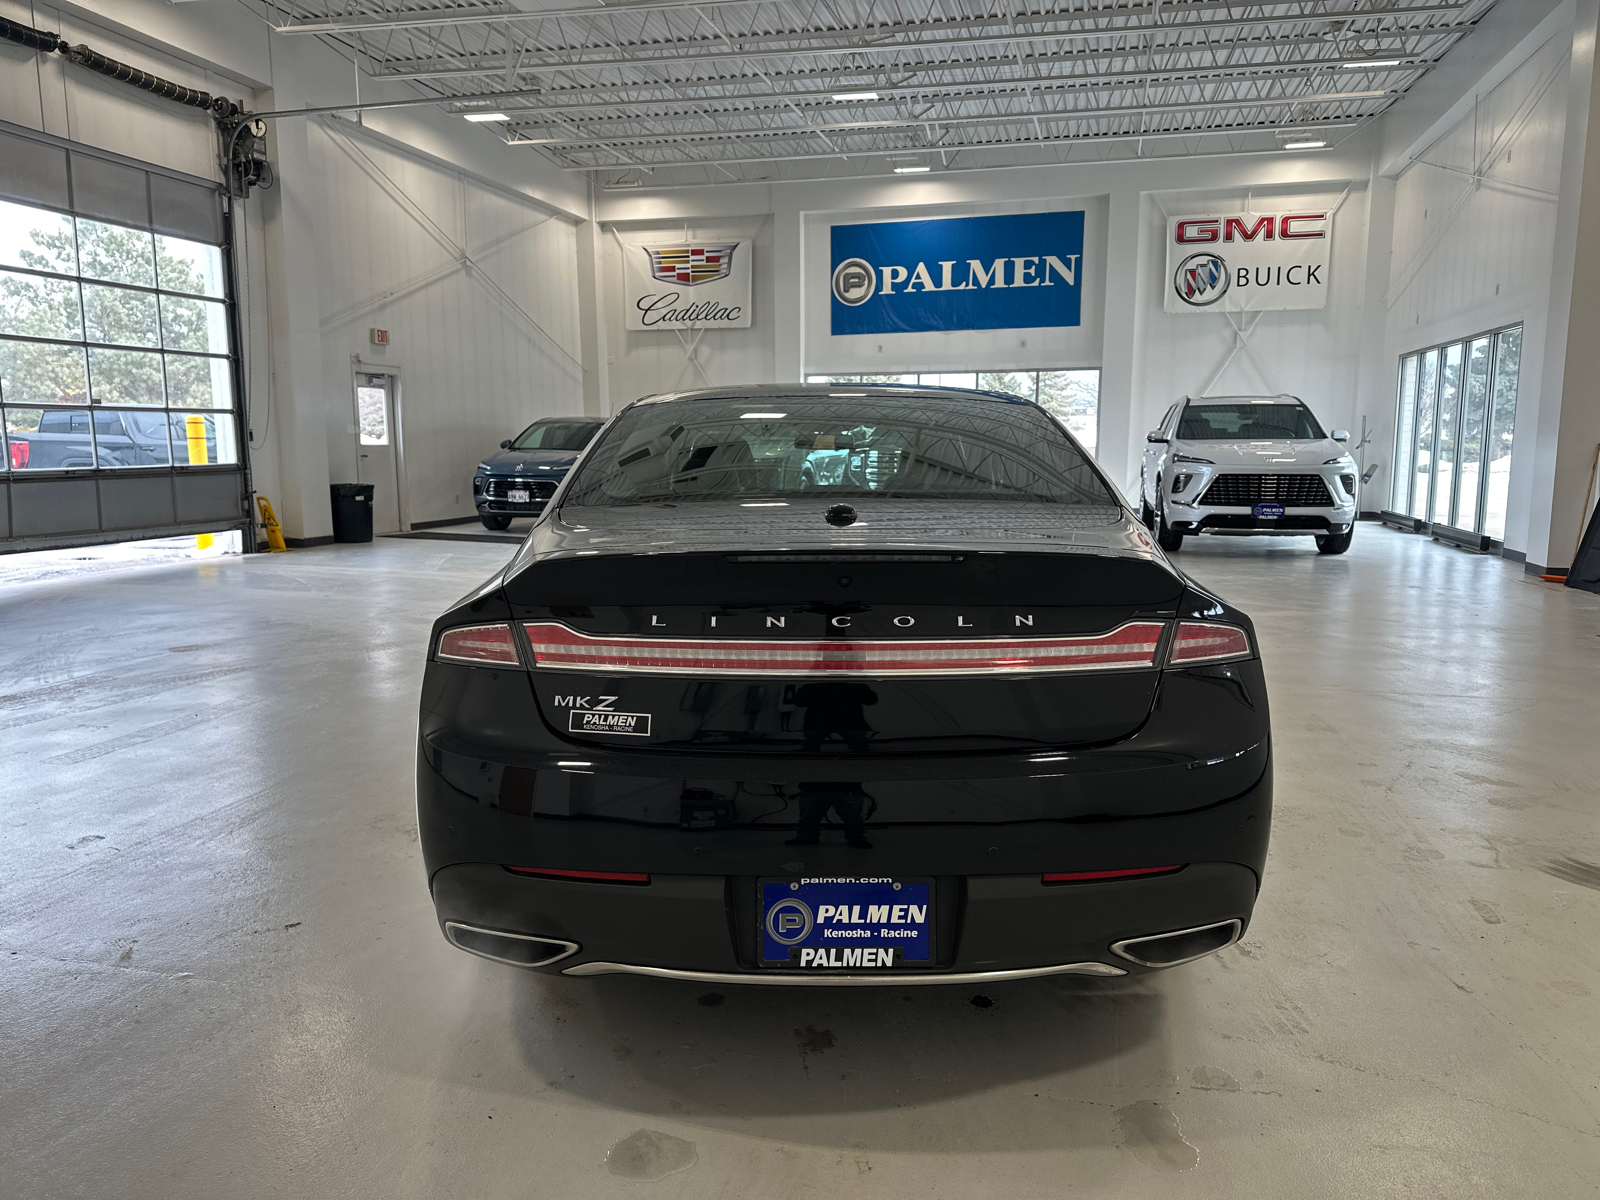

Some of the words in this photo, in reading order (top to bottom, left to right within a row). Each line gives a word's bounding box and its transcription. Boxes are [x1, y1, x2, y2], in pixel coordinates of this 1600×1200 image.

[1175, 212, 1327, 245] GMC
[878, 254, 1080, 295] PALMEN
[1236, 265, 1322, 287] BUICK
[637, 292, 741, 326] Cadillac
[377, 329, 388, 343] EXIT
[651, 614, 1033, 627] LINCOLN
[554, 695, 618, 711] MKZ
[583, 714, 636, 726] PALMEN
[801, 877, 892, 885] palmen.com
[816, 905, 927, 924] PALMEN
[824, 929, 871, 938] Kenosha
[881, 929, 918, 938] Racine
[800, 948, 894, 967] PALMEN
